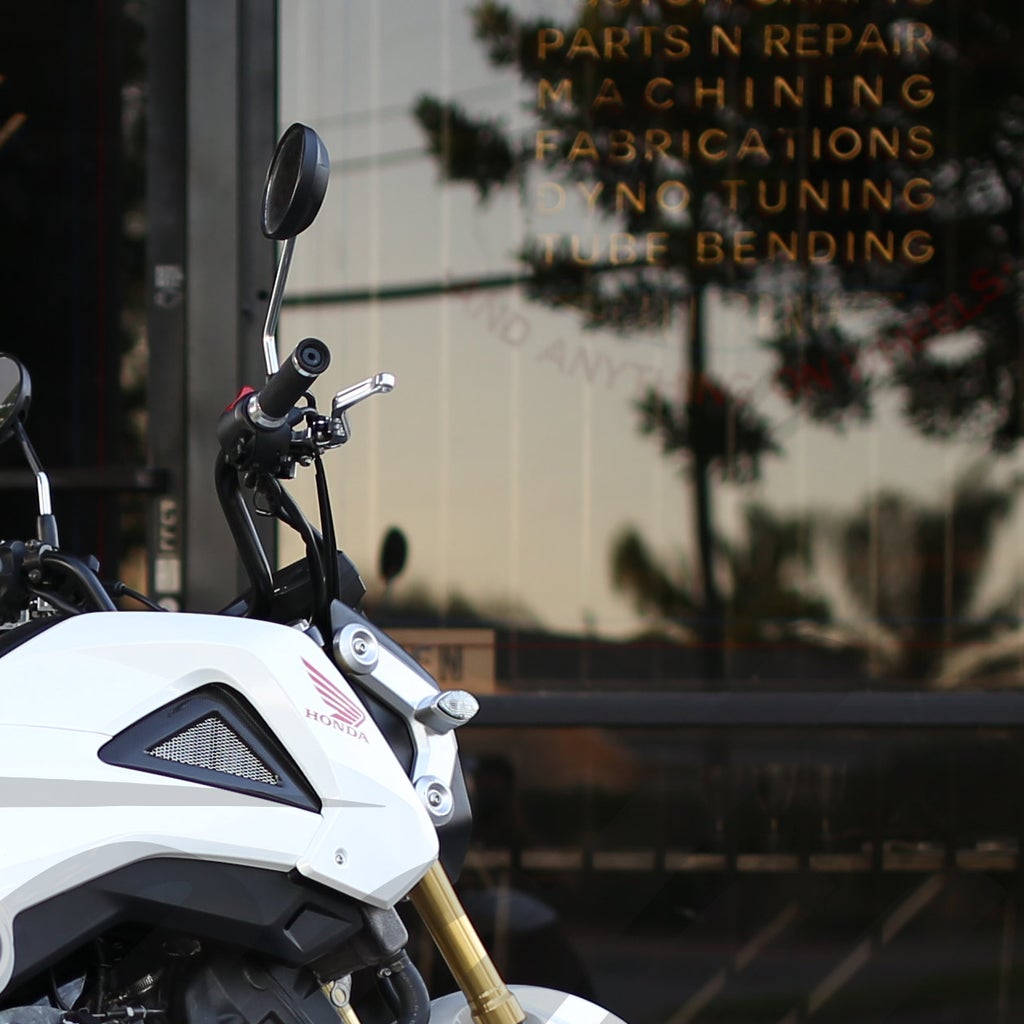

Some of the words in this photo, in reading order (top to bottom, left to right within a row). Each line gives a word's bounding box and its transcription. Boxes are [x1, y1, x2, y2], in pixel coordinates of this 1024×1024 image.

[536, 24, 691, 60] PARTS
[711, 24, 742, 57] N
[763, 23, 934, 58] REPAIR
[536, 73, 936, 110] MACHINING
[534, 126, 936, 163] FABRICATIONS
[536, 179, 692, 214] DYNO
[720, 178, 936, 213] TUNING
[536, 231, 671, 265] TUBE
[695, 229, 936, 265] BENDING
[304, 706, 371, 745] HONDA
